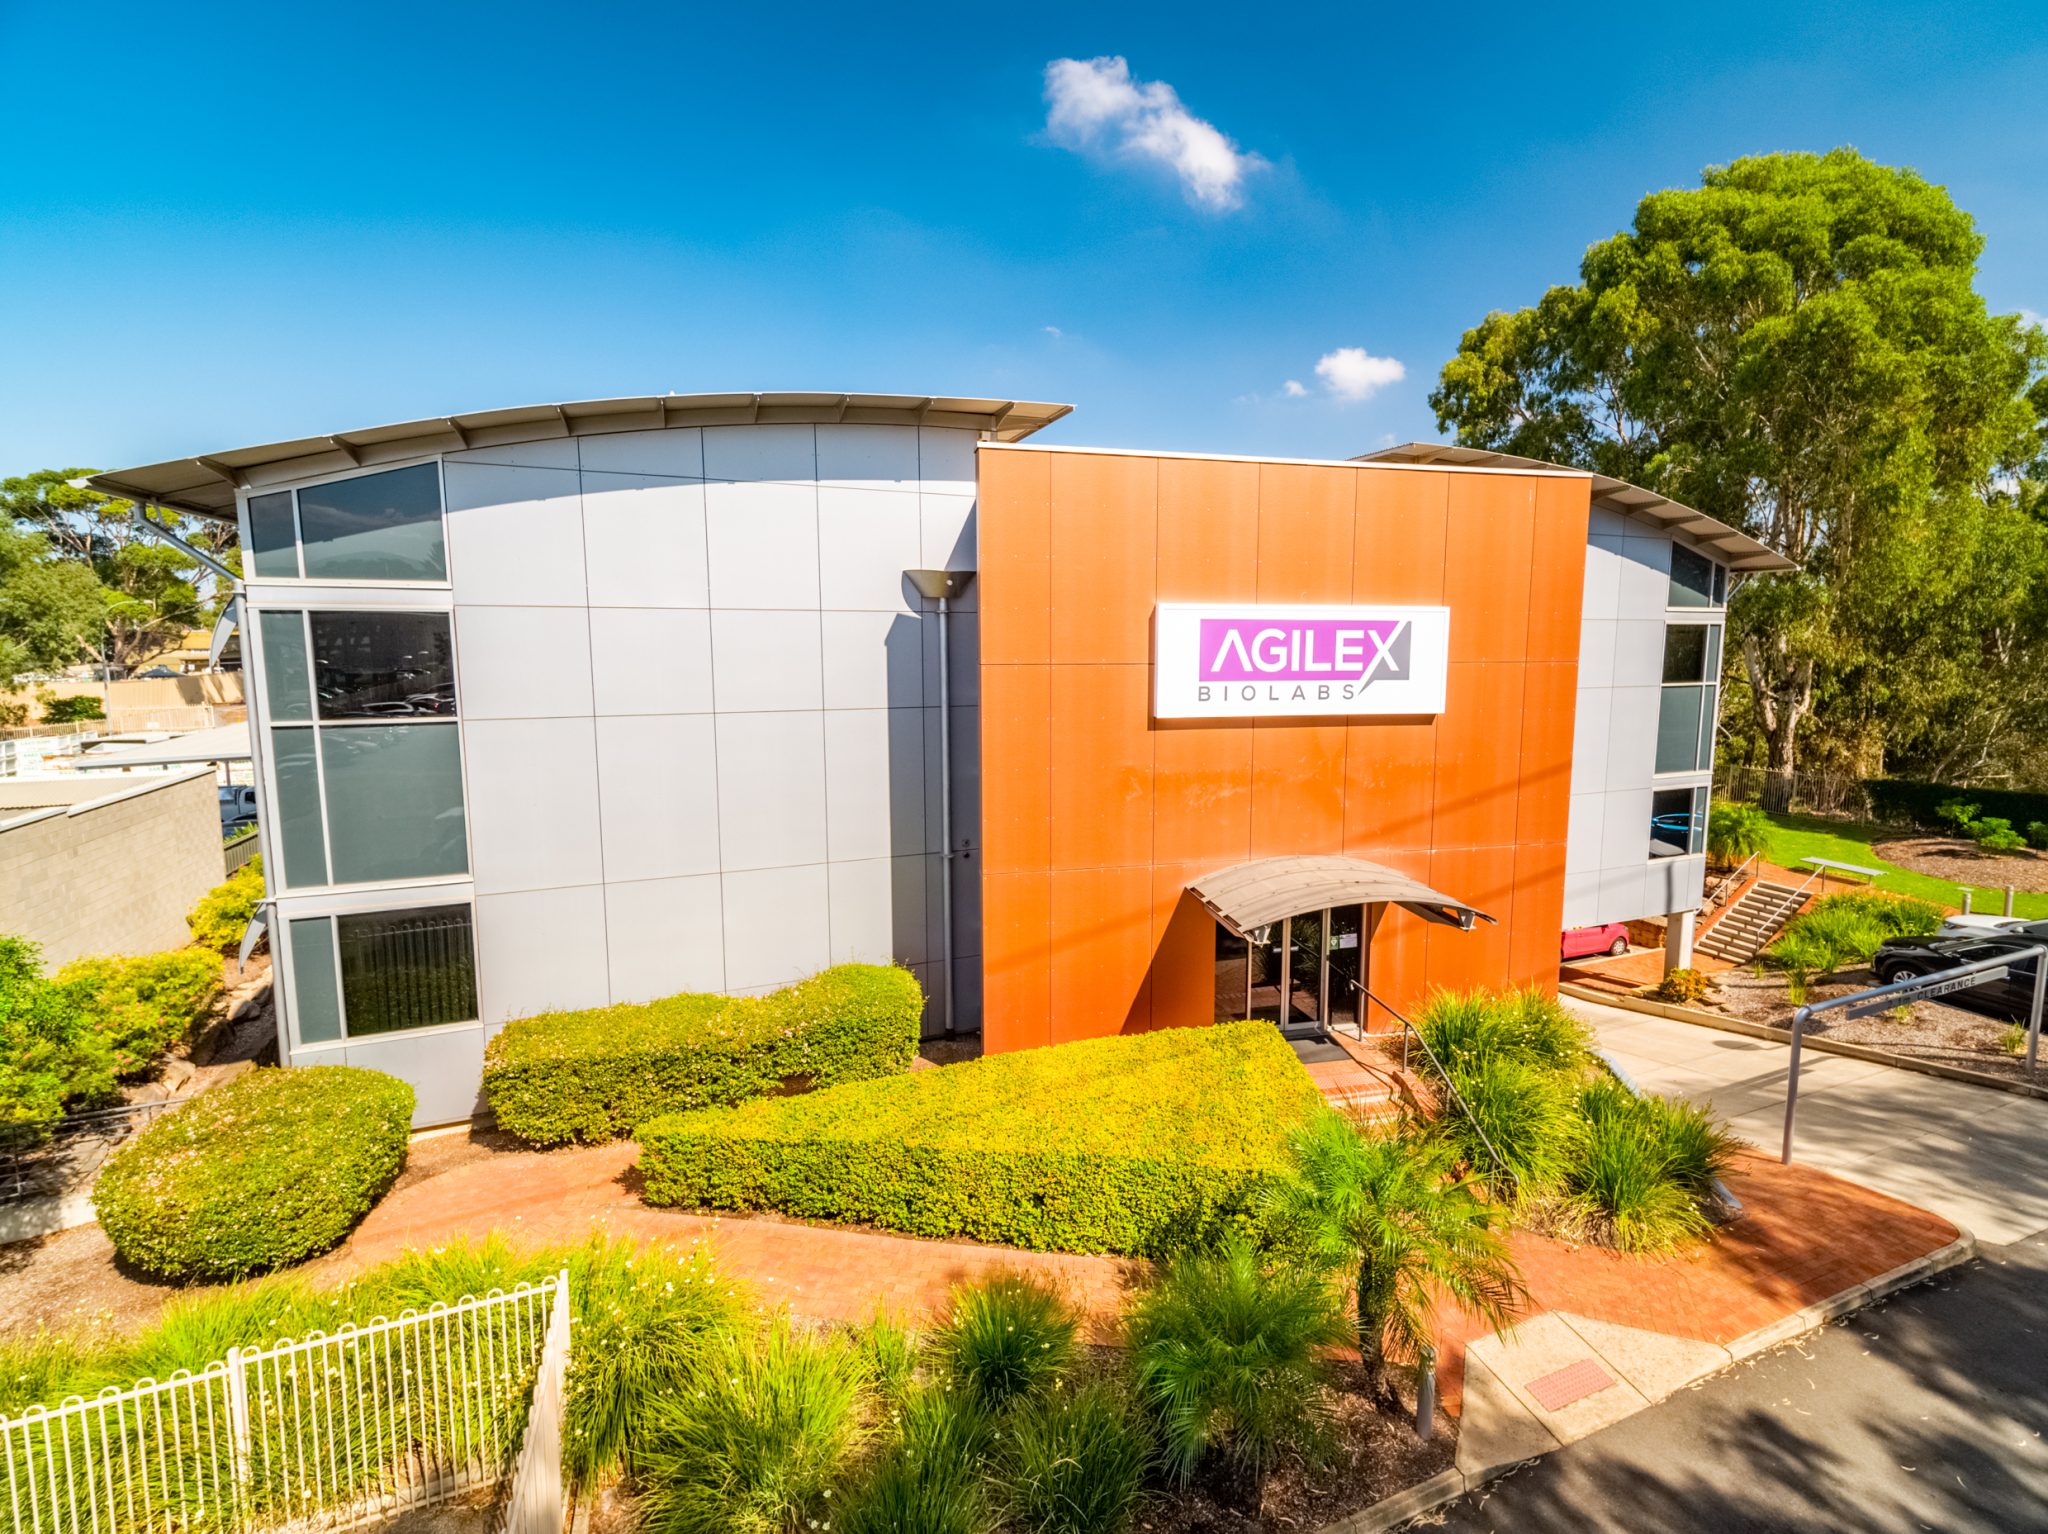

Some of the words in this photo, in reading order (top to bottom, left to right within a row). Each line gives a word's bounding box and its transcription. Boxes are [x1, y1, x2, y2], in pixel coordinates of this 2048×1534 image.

[1209, 622, 1403, 676] AGILEX
[1198, 684, 1354, 702] BIOLABS
[1917, 976, 1977, 1001] CLEARANCE
